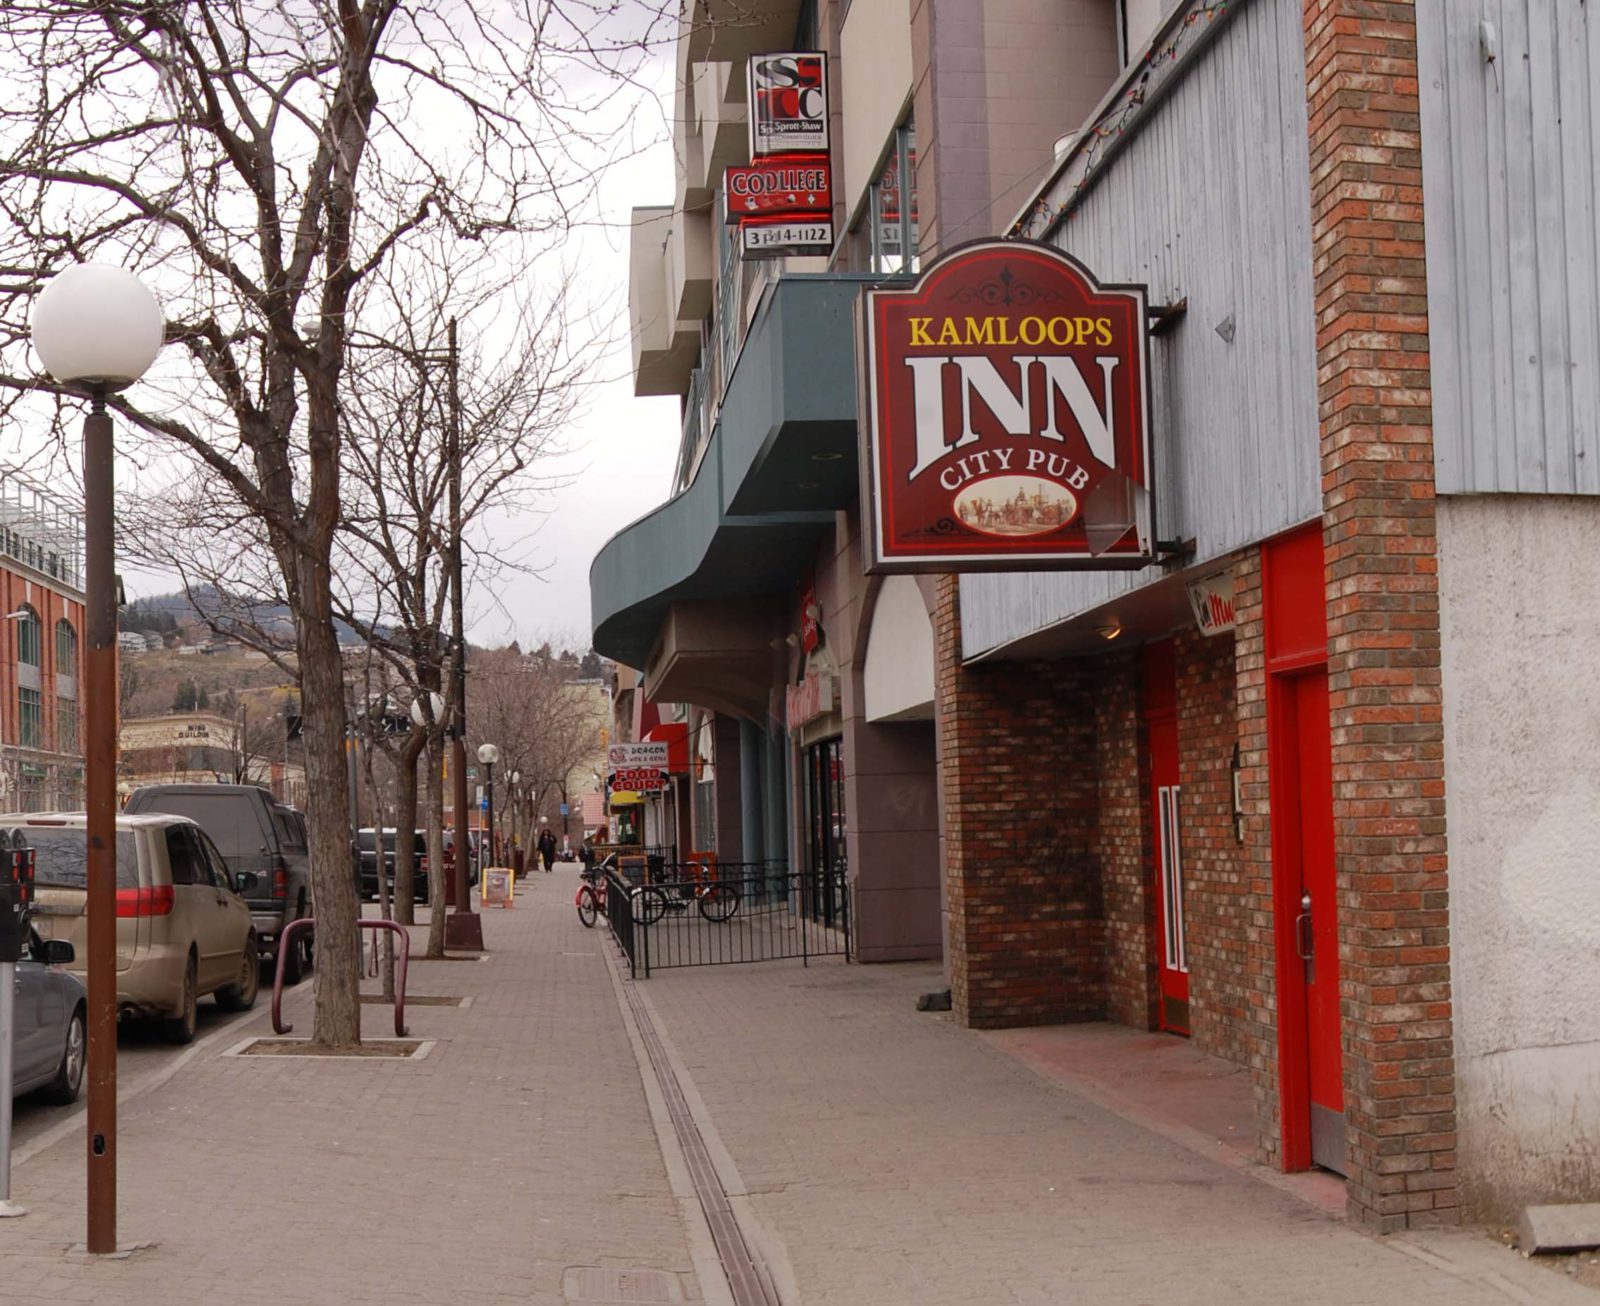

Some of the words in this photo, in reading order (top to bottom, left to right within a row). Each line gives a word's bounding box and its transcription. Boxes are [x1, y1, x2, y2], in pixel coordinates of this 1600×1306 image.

[908, 316, 1113, 346] KAMLOOPS
[904, 355, 1120, 481] INN
[939, 447, 1014, 491] CITY
[1026, 448, 1090, 490] PUB
[611, 778, 666, 793] COURT
[614, 768, 660, 780] FOOD
